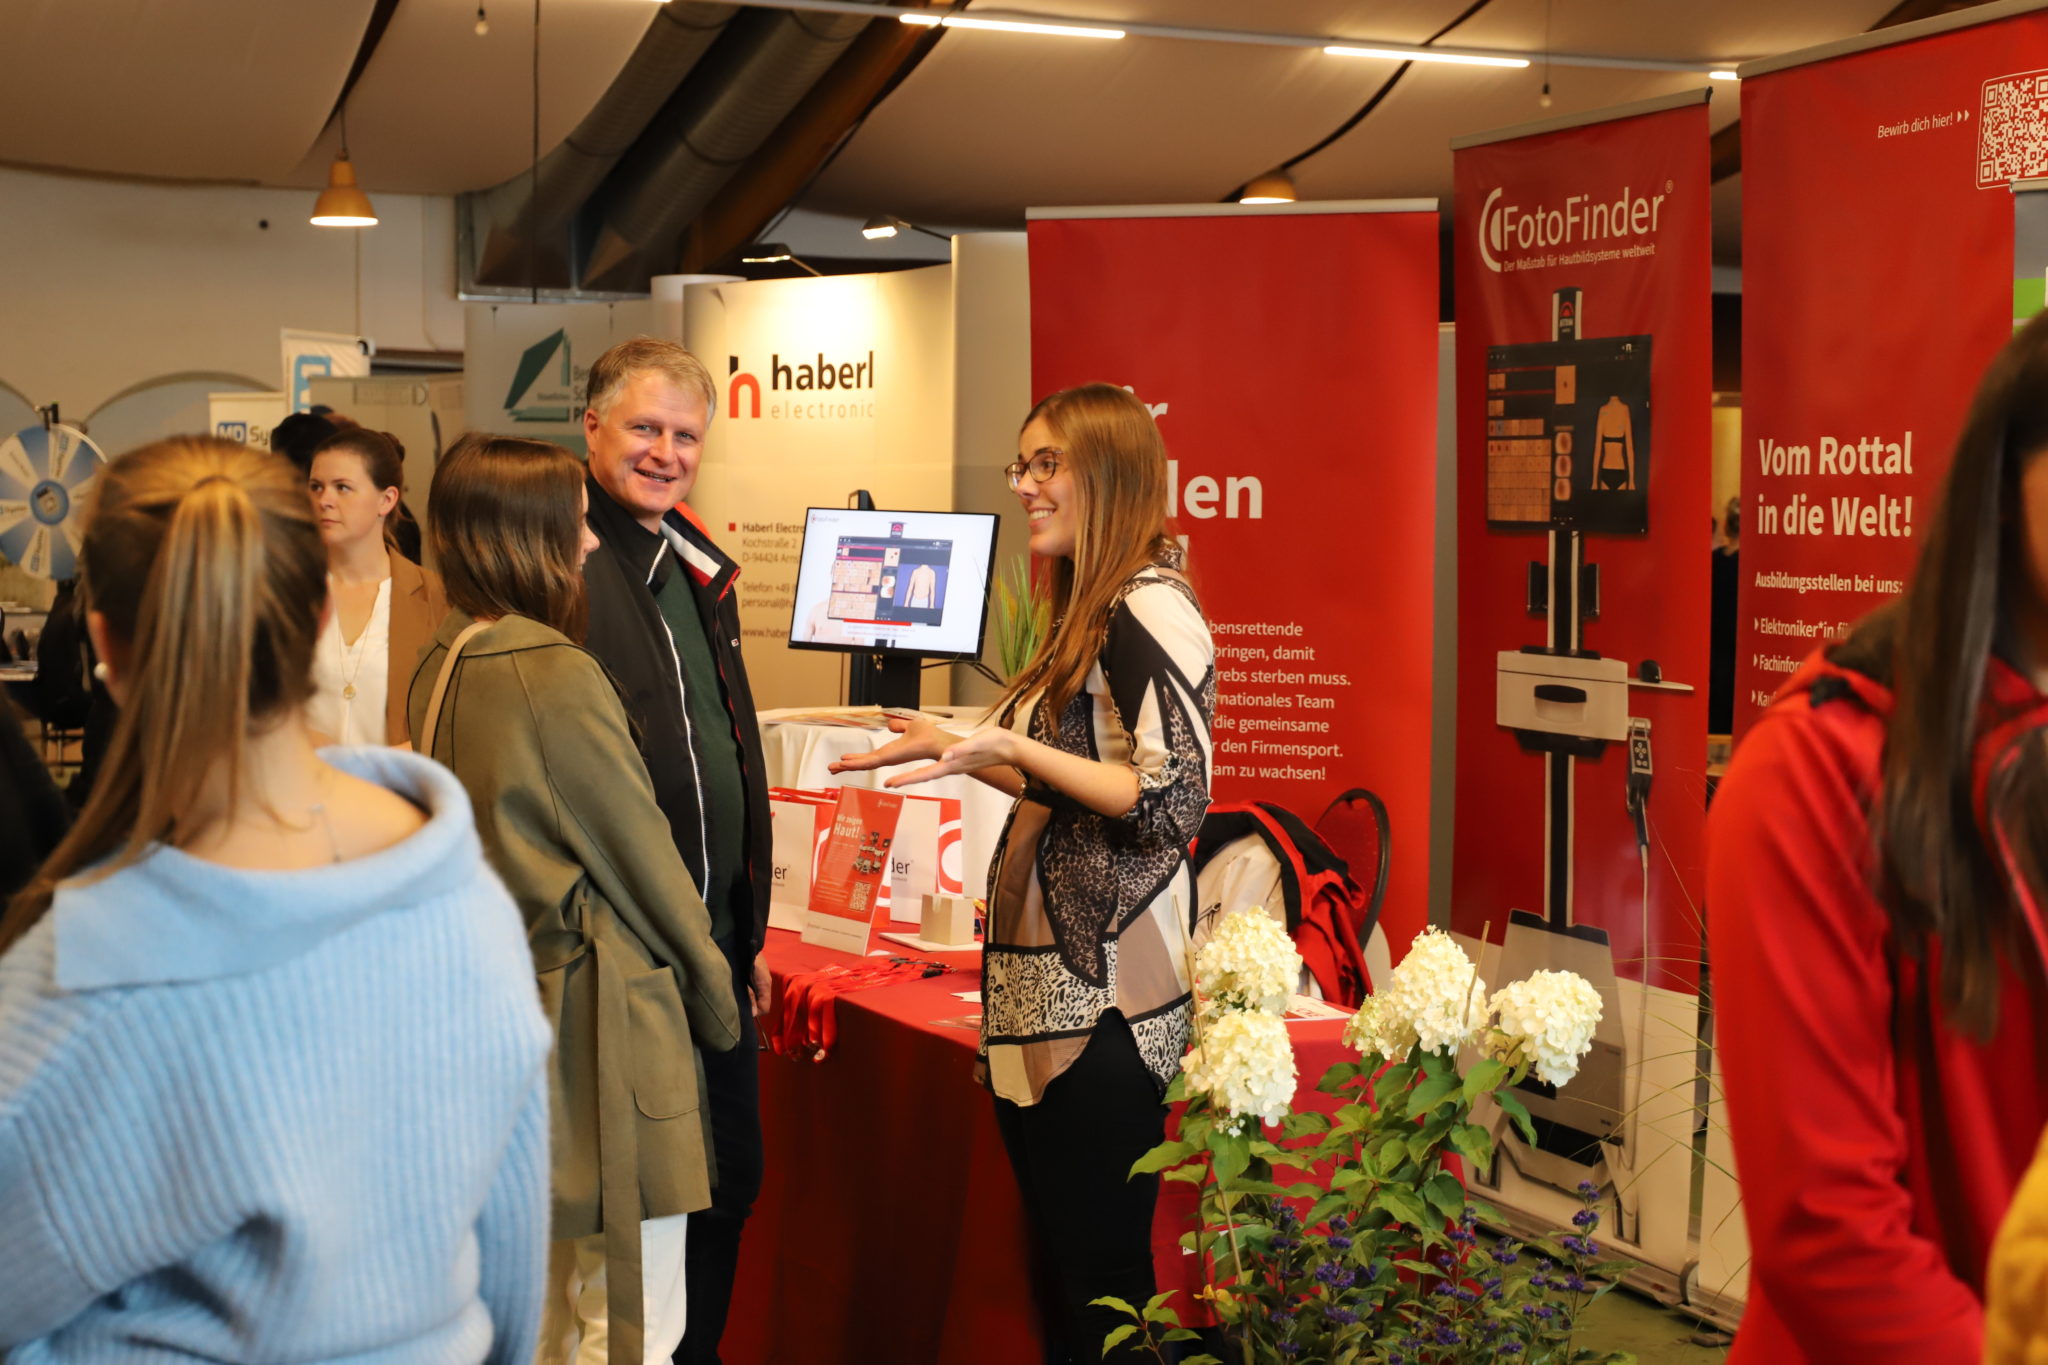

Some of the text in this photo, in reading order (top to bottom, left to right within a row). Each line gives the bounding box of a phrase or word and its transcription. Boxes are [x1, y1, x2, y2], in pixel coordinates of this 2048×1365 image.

[1878, 112, 1953, 138] Bewirb dich hier!
[1503, 186, 1665, 251] FotoFinder
[1503, 243, 1656, 272] Der Maßstab für Hautbildsysteme weltweit
[771, 350, 874, 390] haberl
[771, 401, 874, 419] electronic
[249, 425, 269, 446] Sy
[1759, 431, 1913, 476] Vom Rottal
[1757, 494, 1913, 537] in die Welt!
[742, 522, 773, 533] Haberl
[742, 538, 790, 549] Kochstraße
[742, 582, 773, 593] Telefon
[1755, 571, 1904, 594] Ausbildungsstellen bei uns:
[1208, 620, 1304, 637] bensrettende
[1213, 644, 1316, 662] bringen, damit
[1759, 654, 1802, 674] Fachinfor
[1217, 668, 1352, 686] rebs sterben muss.
[1217, 692, 1336, 709] nationales Team
[1213, 715, 1330, 734] die gemeinsame
[1220, 738, 1248, 753] den
[1250, 740, 1344, 760] Firmensport.
[1239, 766, 1256, 778] zu
[1258, 765, 1327, 781] wachsen!
[832, 823, 861, 839] Haut!
